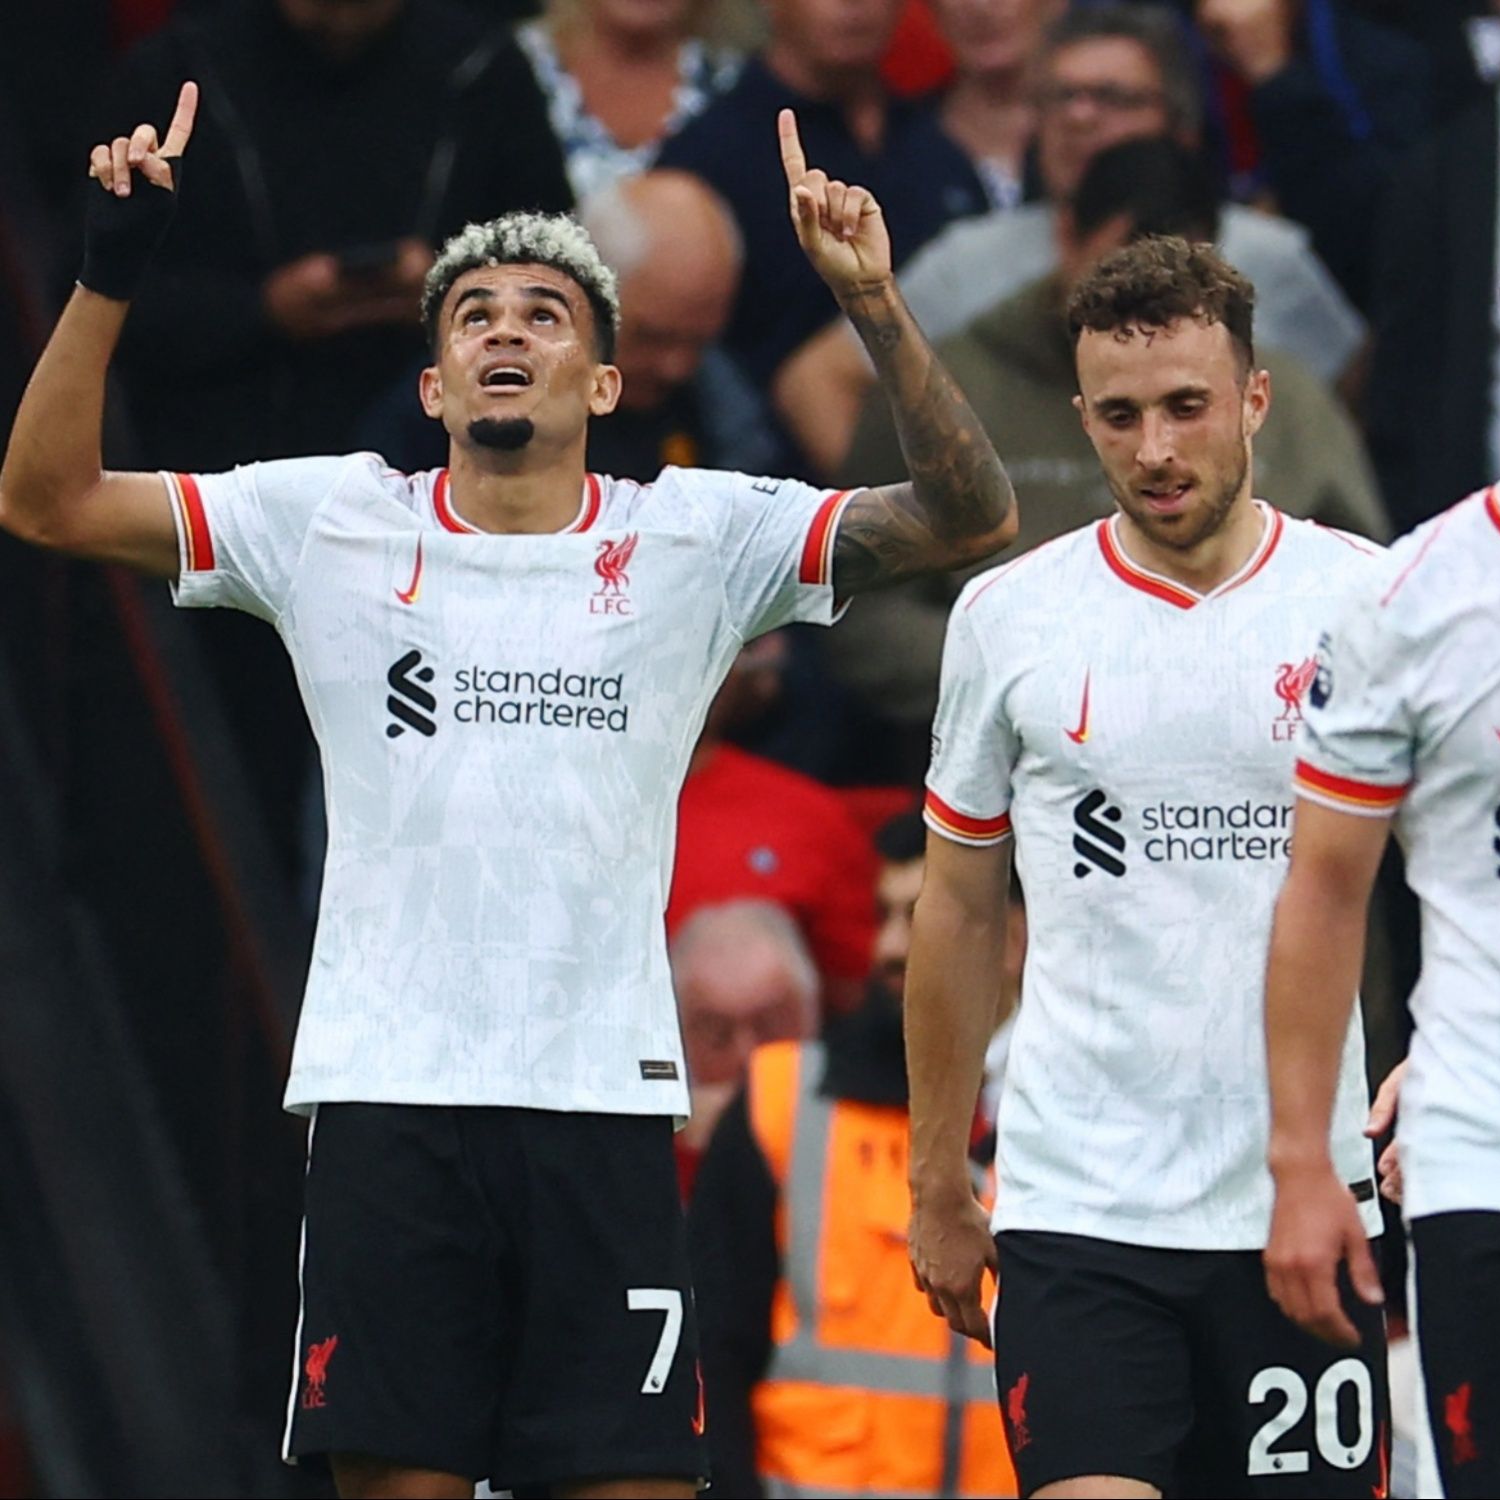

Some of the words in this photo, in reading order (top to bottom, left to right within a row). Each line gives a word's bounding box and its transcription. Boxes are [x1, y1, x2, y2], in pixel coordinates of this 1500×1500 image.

[453, 664, 625, 702] standard
[453, 694, 629, 734] chartered
[1141, 799, 1294, 831] standar
[1143, 830, 1294, 864] chartere
[626, 1287, 684, 1394] 7
[1247, 1357, 1374, 1476] 20
